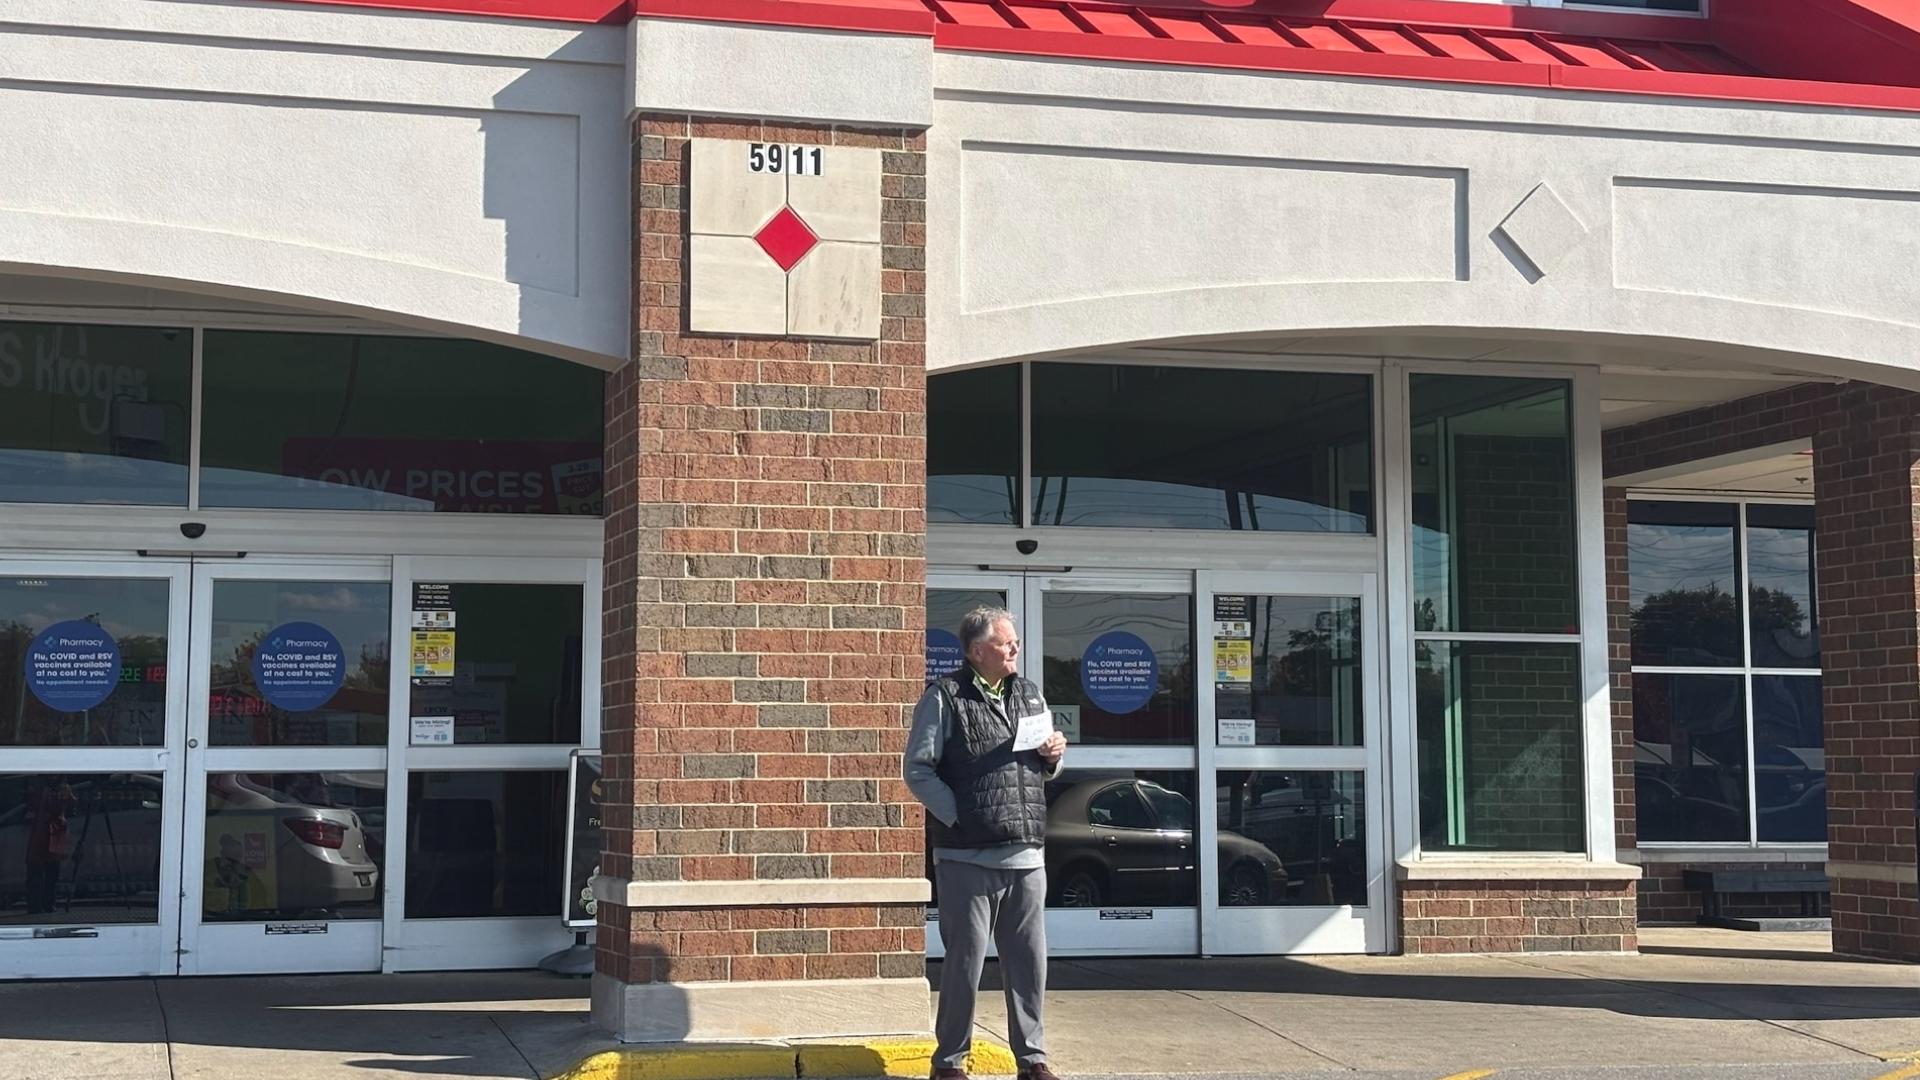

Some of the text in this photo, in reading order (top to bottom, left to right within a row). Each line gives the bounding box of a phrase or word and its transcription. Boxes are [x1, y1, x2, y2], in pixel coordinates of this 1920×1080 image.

[750, 143, 821, 176] 5911
[405, 468, 544, 498] PRICES
[60, 638, 104, 647] Pharmacy
[286, 640, 328, 648] Pharmacy
[926, 646, 960, 655] harmacy
